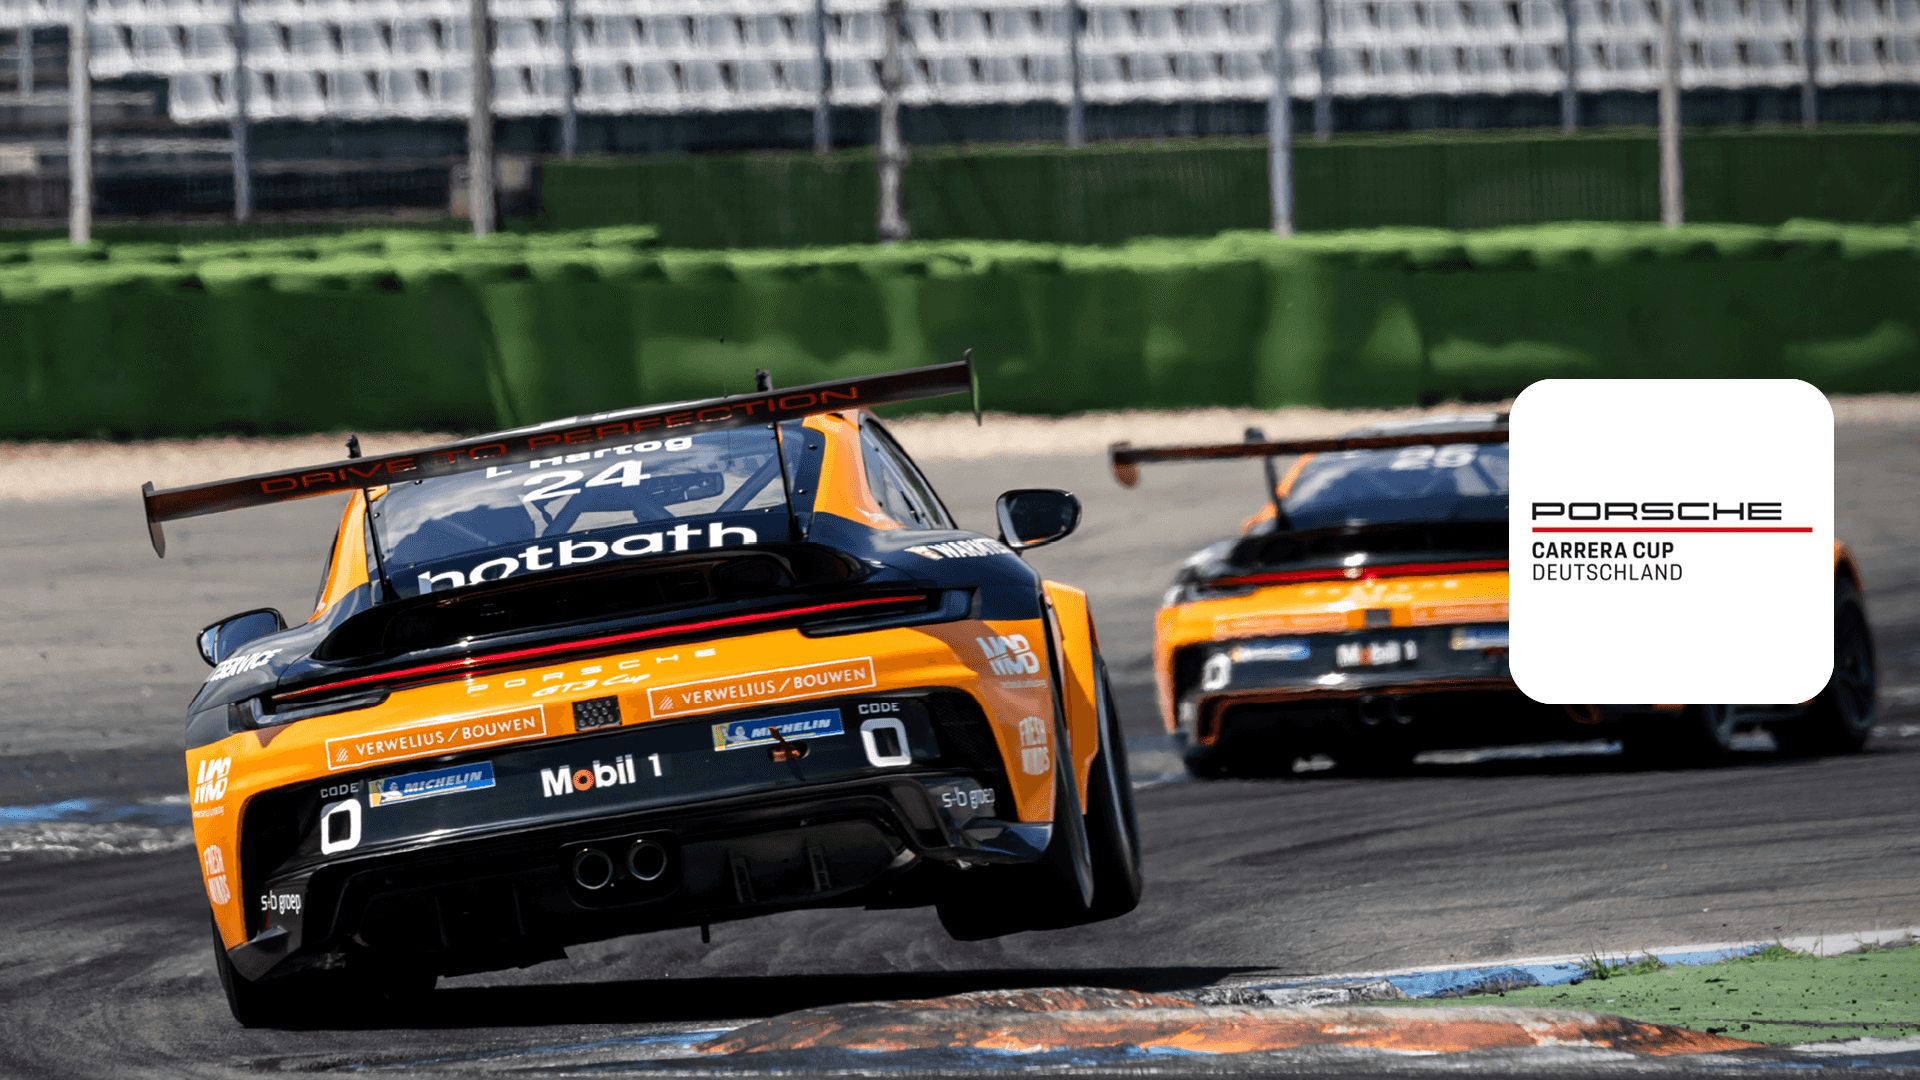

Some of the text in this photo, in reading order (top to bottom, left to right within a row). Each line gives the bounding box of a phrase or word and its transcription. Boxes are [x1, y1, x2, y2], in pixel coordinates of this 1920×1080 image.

[260, 386, 859, 494] DRIVE TO PERFECTION
[485, 437, 692, 479] L Hartog
[523, 459, 651, 502] 24
[418, 522, 757, 595] hotbath
[466, 648, 717, 694] PORSCHE
[532, 673, 651, 697] GT3 Cup
[857, 702, 900, 715] CODE
[860, 717, 912, 767] 0
[320, 782, 360, 799] CODE
[403, 771, 483, 793] MICHELIN
[540, 753, 663, 798] Mobil 1
[320, 798, 362, 855] 0
[278, 893, 302, 915] groep
